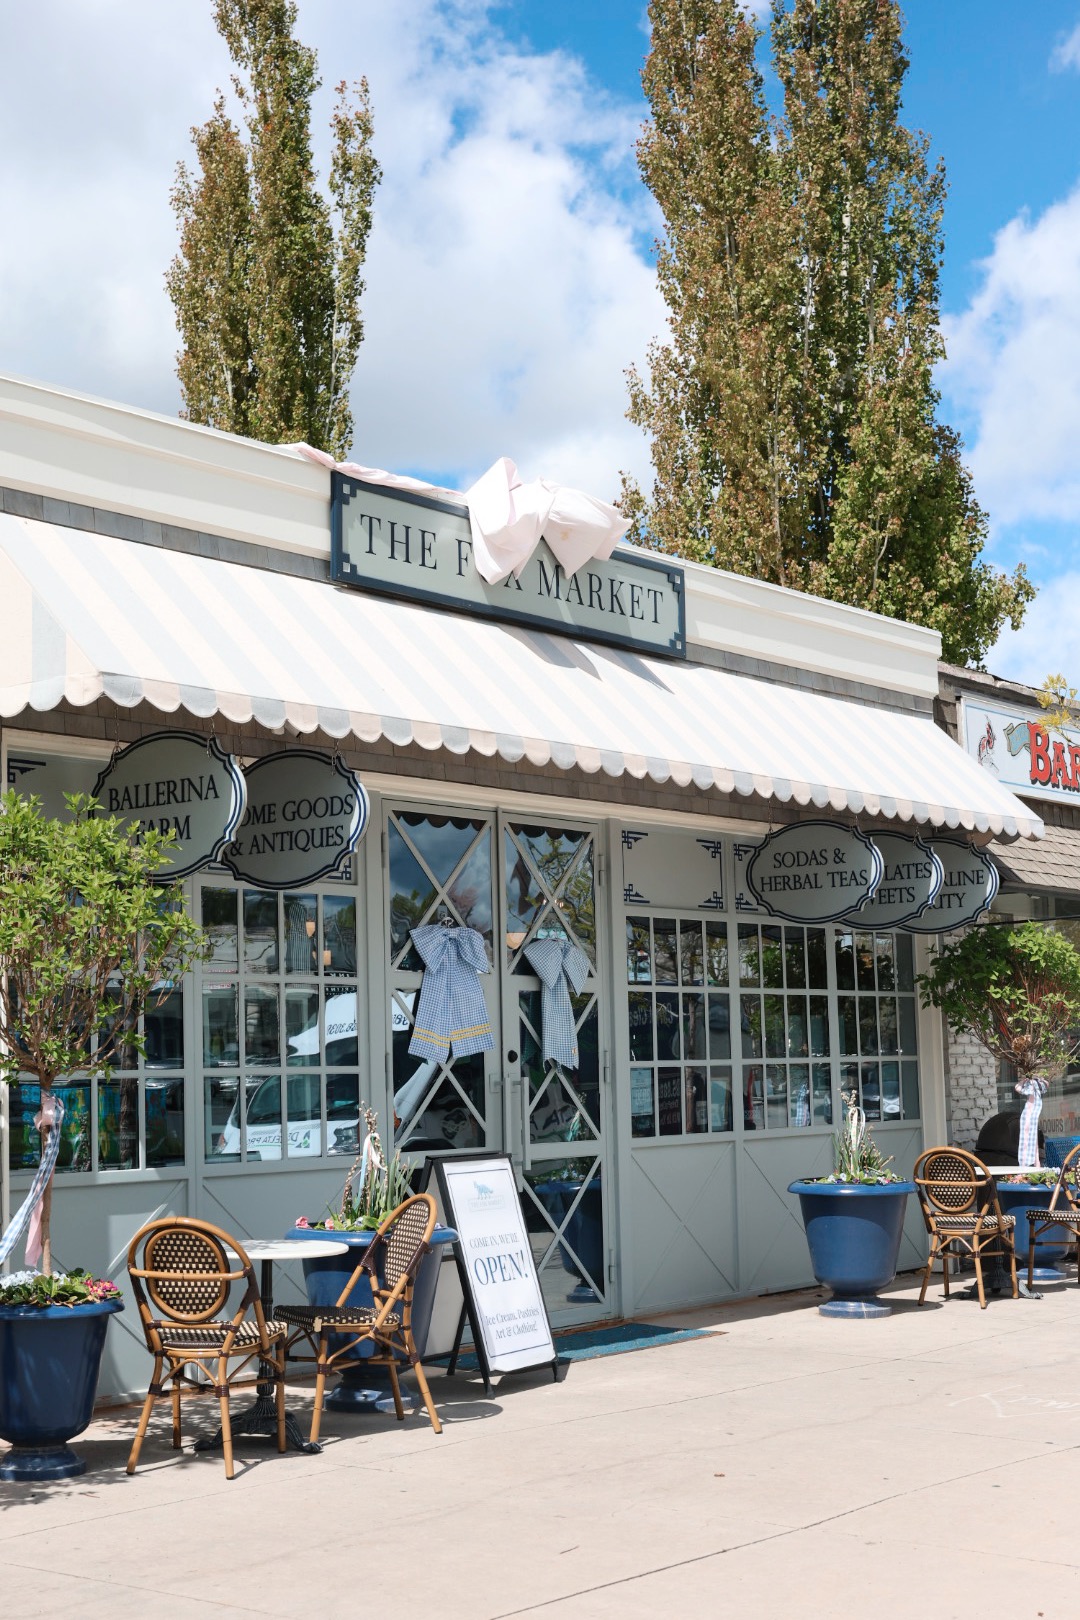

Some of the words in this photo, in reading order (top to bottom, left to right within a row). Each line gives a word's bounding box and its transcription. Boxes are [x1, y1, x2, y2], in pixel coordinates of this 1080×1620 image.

[360, 514, 437, 570] THE
[537, 559, 664, 624] MARKET
[108, 774, 220, 813] BALLERINA
[282, 794, 354, 822] GOODS
[230, 837, 243, 857] &
[249, 825, 345, 856] ANTIQUES
[773, 848, 828, 869] SODAS
[833, 847, 847, 865] &
[760, 873, 823, 893] HERBAL
[827, 869, 868, 888] TEAS
[469, 1236, 490, 1249] COME
[474, 1249, 529, 1286] OPEN!
[485, 1315, 496, 1326] Ice
[495, 1328, 506, 1340] Art
[506, 1326, 512, 1337] &
